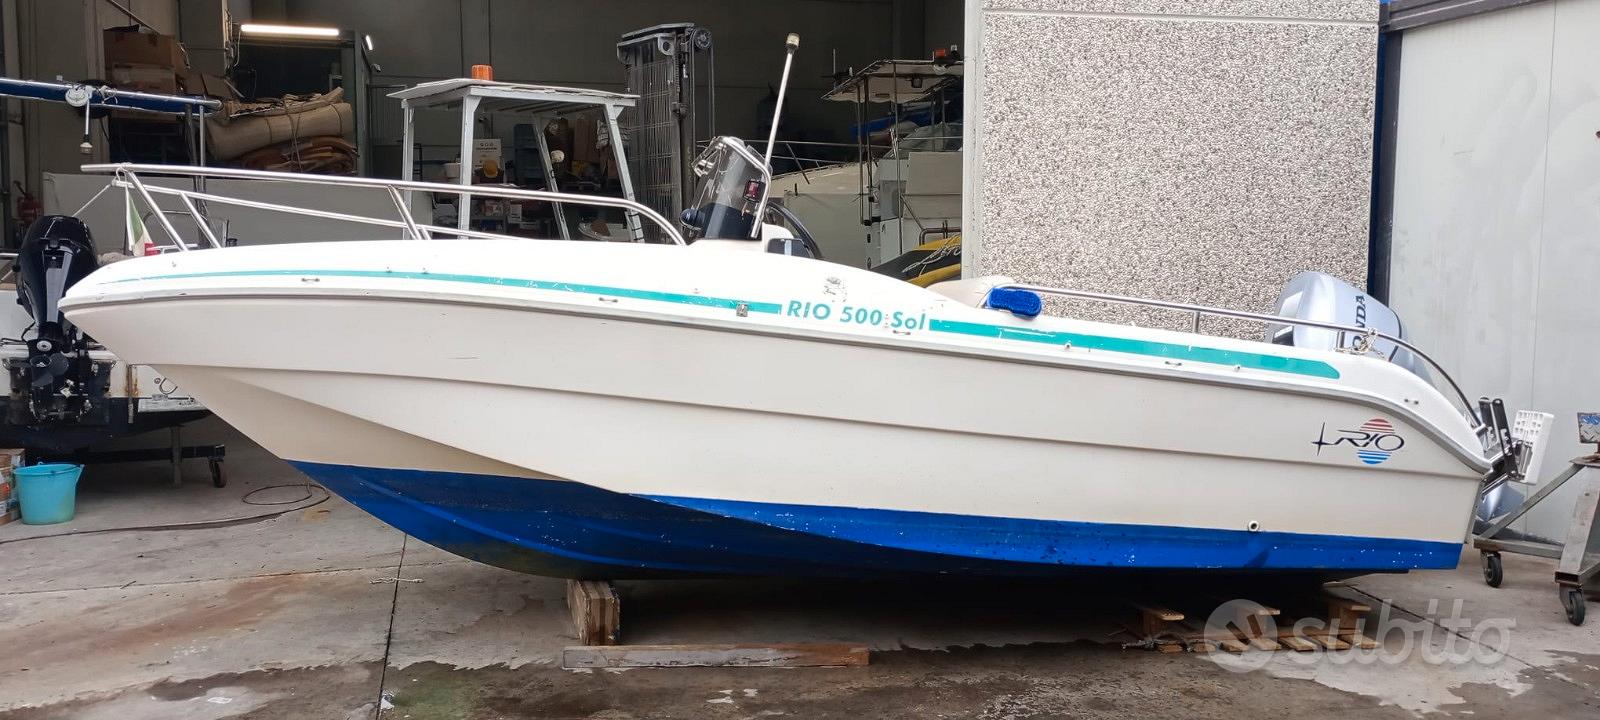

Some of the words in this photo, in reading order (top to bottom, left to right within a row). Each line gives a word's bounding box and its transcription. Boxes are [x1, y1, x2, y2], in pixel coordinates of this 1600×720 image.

[787, 300, 831, 320] RIO
[840, 306, 882, 326] 500
[891, 311, 926, 330] Sol
[1352, 295, 1367, 351] ONDA
[1328, 428, 1405, 452] RIO
